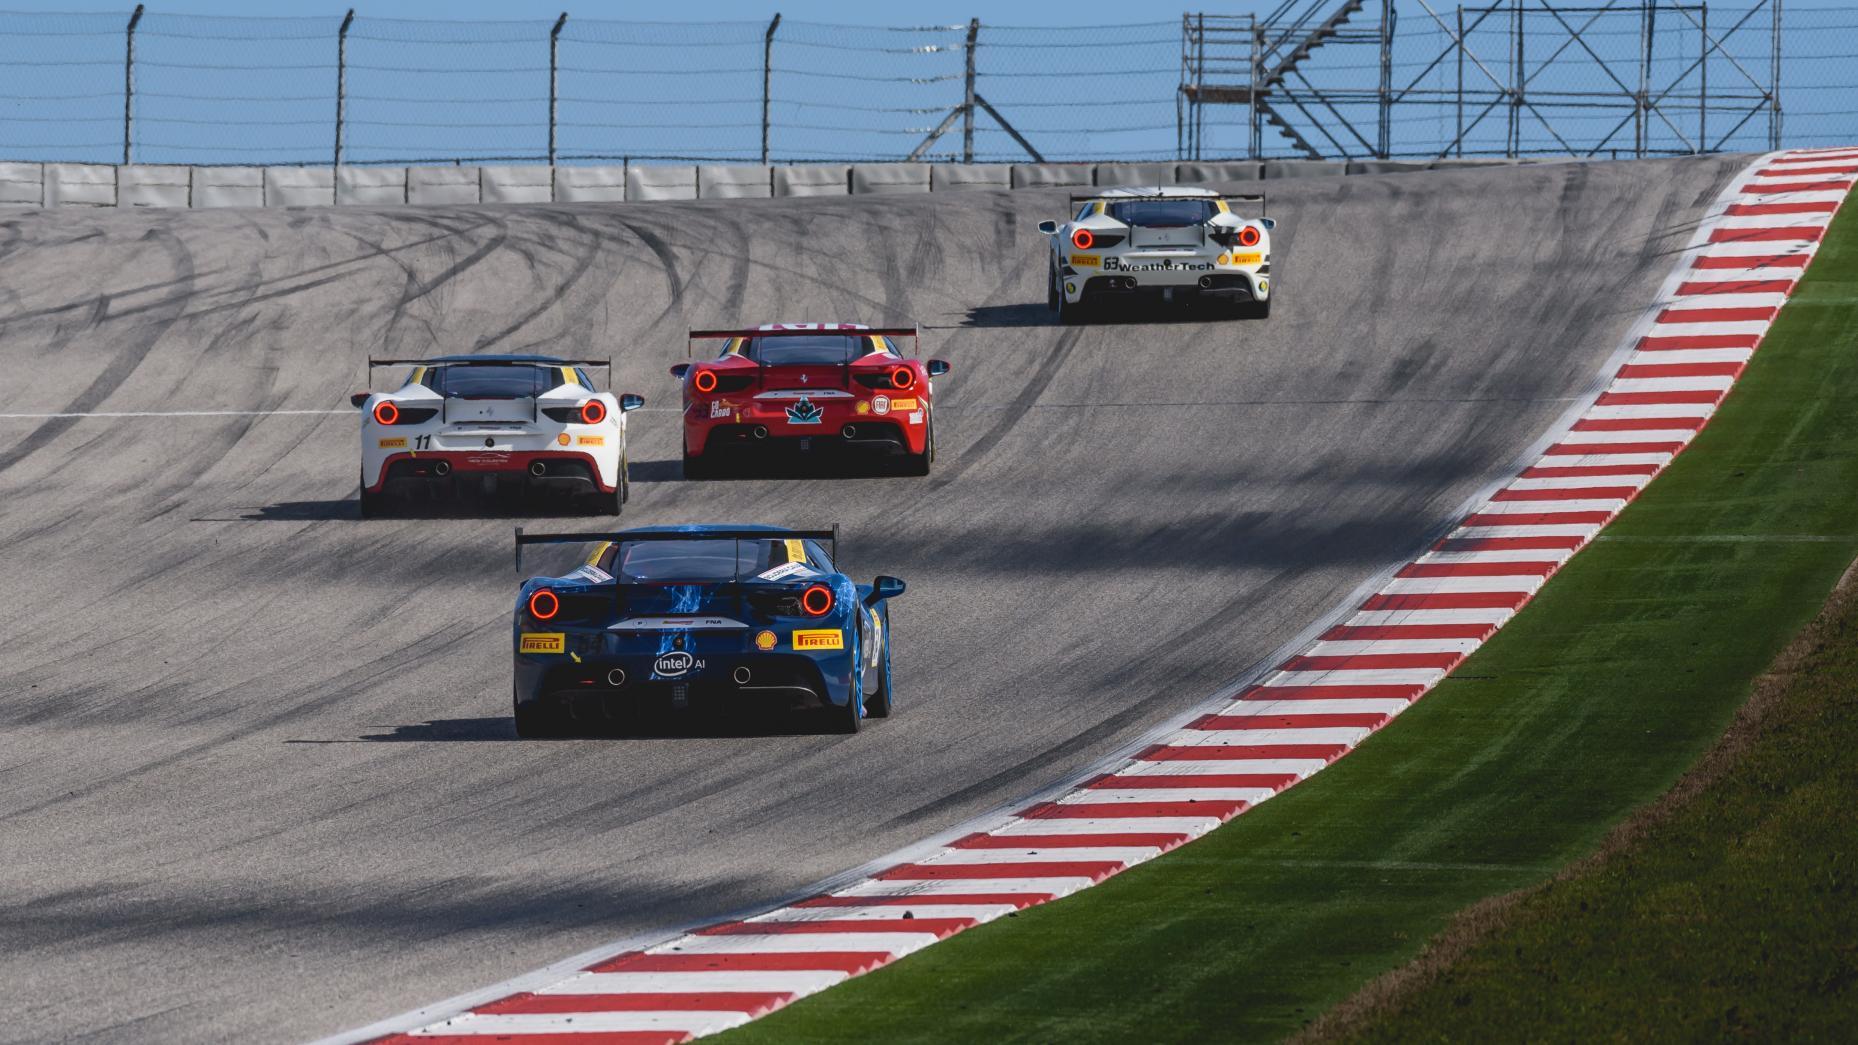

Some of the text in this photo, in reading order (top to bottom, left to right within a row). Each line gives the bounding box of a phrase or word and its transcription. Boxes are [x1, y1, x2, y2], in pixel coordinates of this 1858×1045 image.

[1104, 256, 1119, 270] 63
[1119, 262, 1215, 272] WeatherTech
[415, 434, 431, 450] 11
[522, 637, 560, 649] PIRELLI
[798, 633, 839, 646] PIRELLI
[659, 656, 705, 669] intel AI
